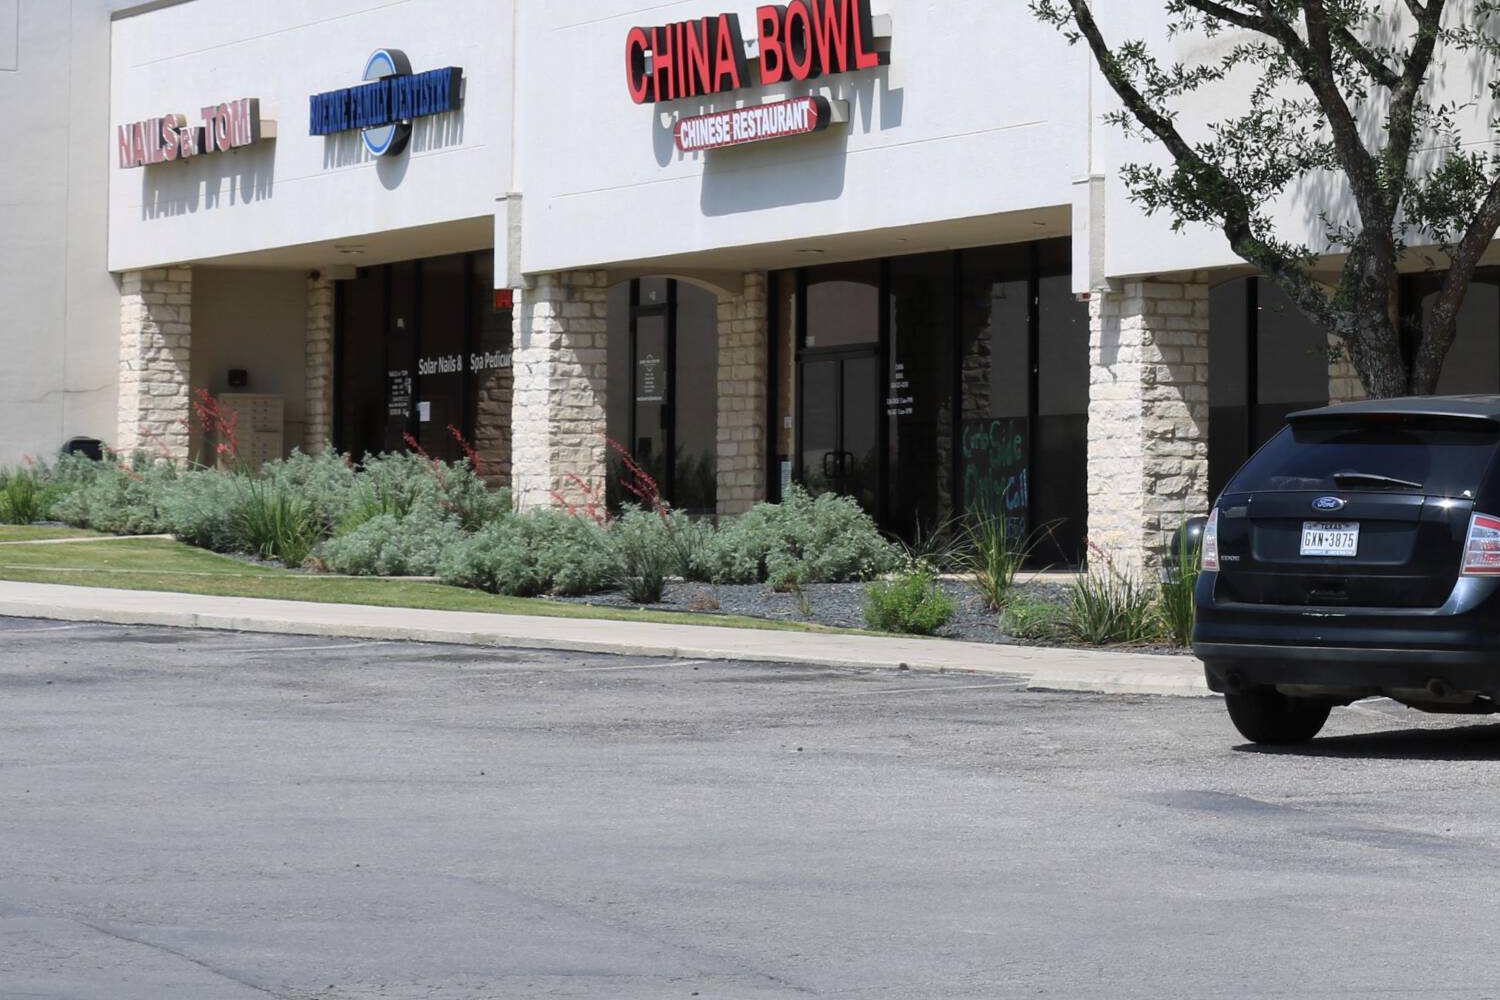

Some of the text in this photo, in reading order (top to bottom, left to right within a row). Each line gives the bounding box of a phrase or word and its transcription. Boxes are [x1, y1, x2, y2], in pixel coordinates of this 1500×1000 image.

[626, 13, 741, 105] CHINA
[117, 99, 252, 169] NAILS BY TOM
[680, 100, 810, 149] CHINESE RESTAURANT
[418, 357, 438, 375] Solar
[438, 354, 456, 374] Nails
[470, 353, 484, 374] Spa
[1320, 522, 1344, 530] TEXAS
